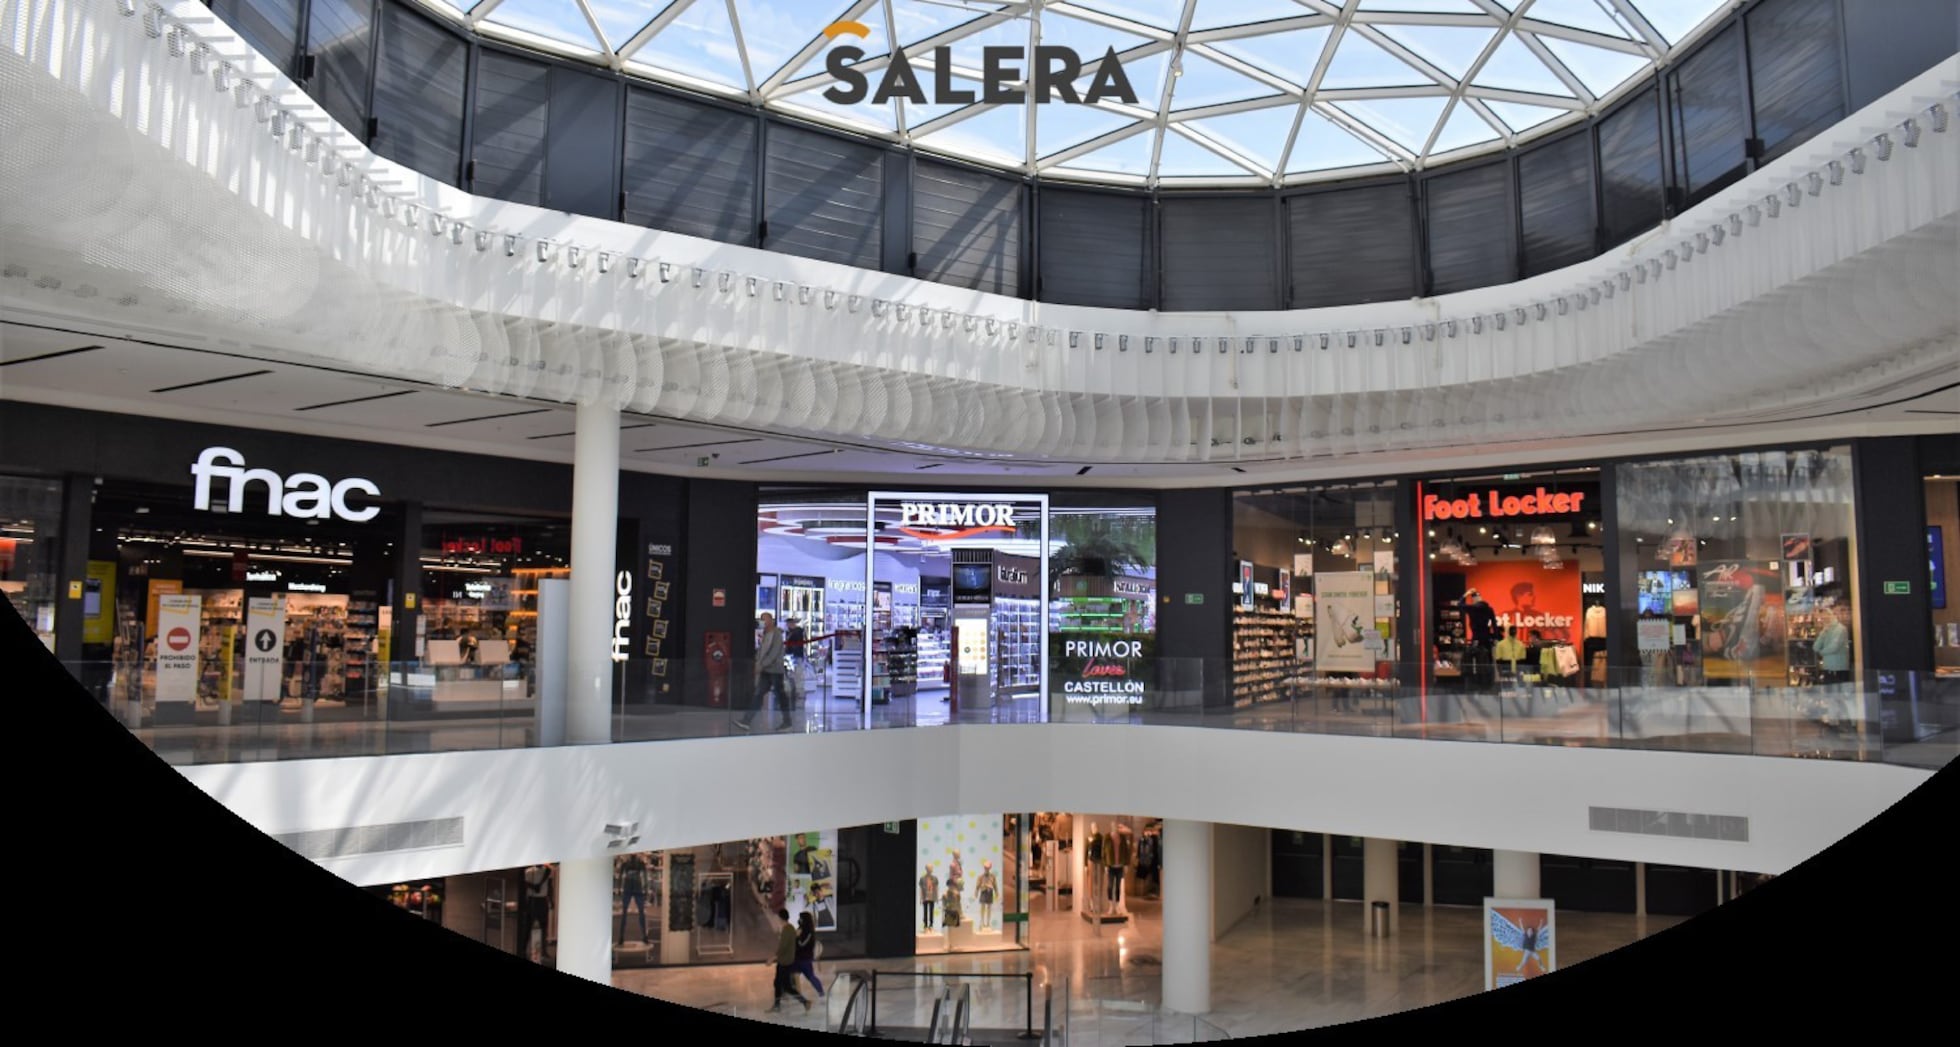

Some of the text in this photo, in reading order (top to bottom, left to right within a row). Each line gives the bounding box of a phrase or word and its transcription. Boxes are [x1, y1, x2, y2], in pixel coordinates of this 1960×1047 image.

[190, 446, 382, 523] fnac
[1423, 486, 1585, 521] Foot Locker
[900, 502, 1017, 527] PRIMOR
[611, 570, 633, 663] fnac
[1515, 612, 1574, 628] Locker
[1065, 640, 1143, 658] PRIMOR
[159, 654, 197, 662] PROHIBIDO
[248, 656, 280, 664] ENTRADA
[1063, 679, 1145, 693] CASTELLÓN
[1065, 693, 1143, 706] www.primor.eu
